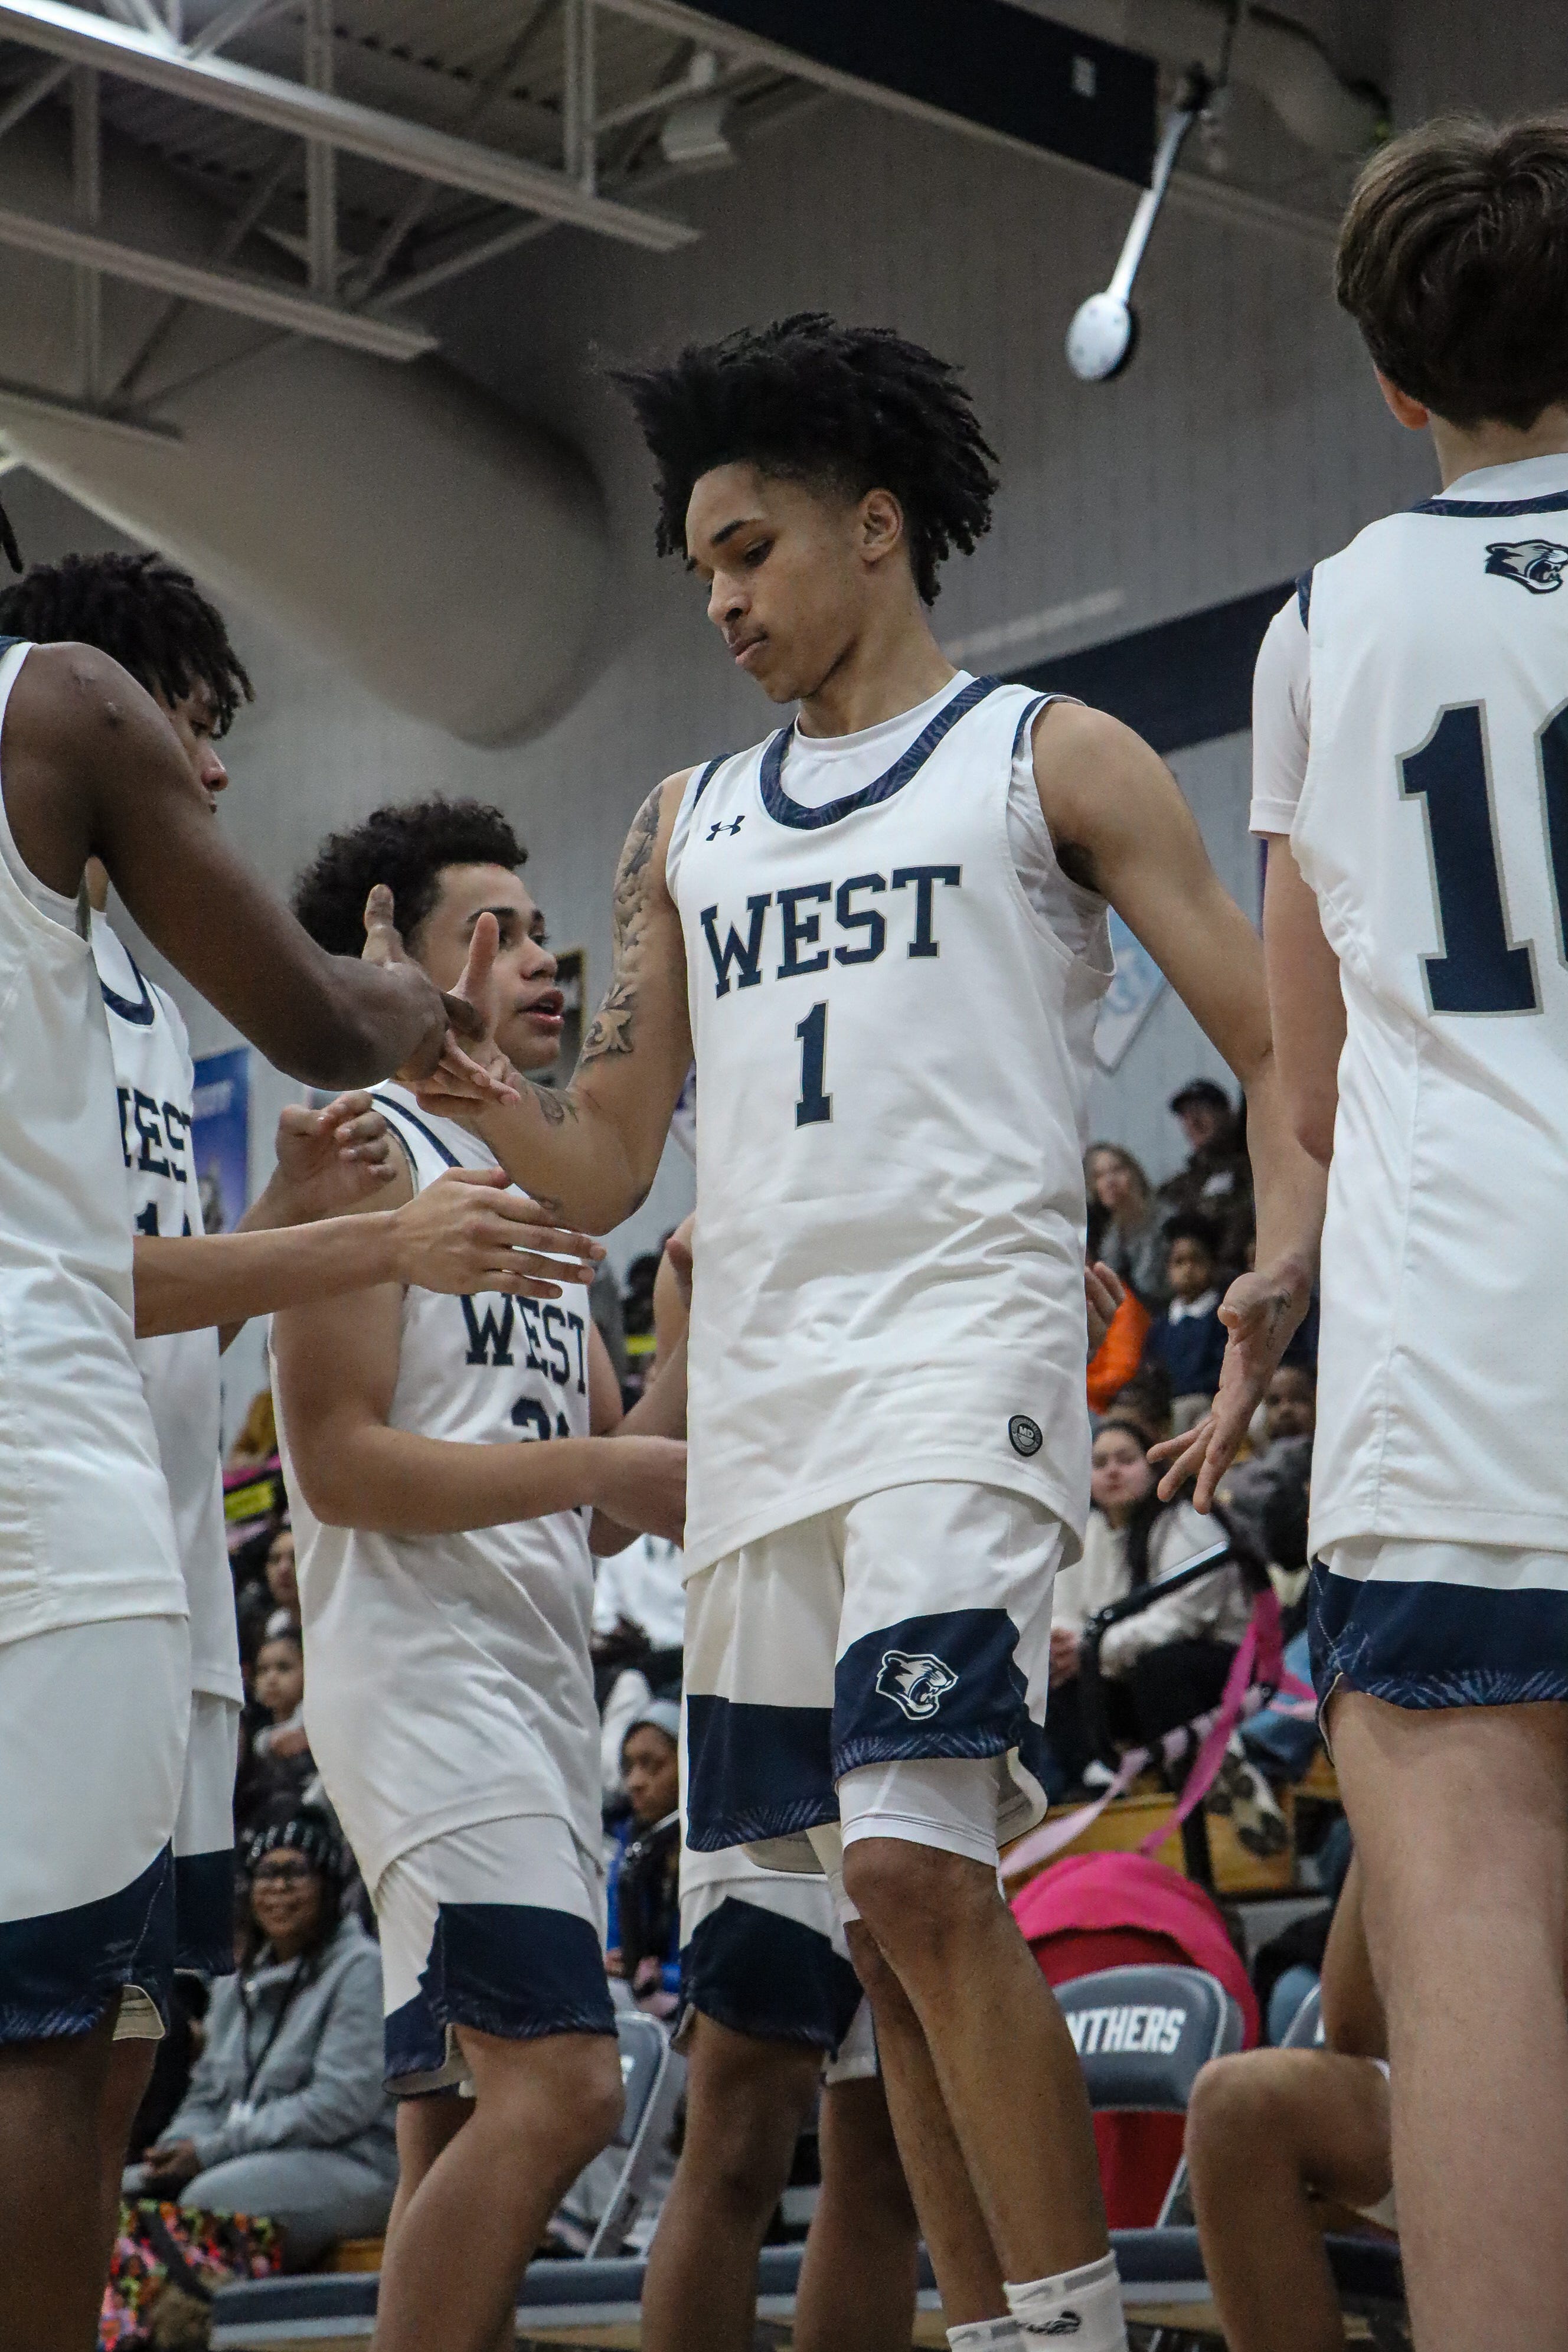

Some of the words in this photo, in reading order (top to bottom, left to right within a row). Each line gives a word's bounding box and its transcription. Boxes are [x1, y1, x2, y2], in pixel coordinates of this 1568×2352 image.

[700, 864, 963, 1000] WEST
[795, 999, 833, 1129] 1
[460, 1293, 586, 1396] WEST
